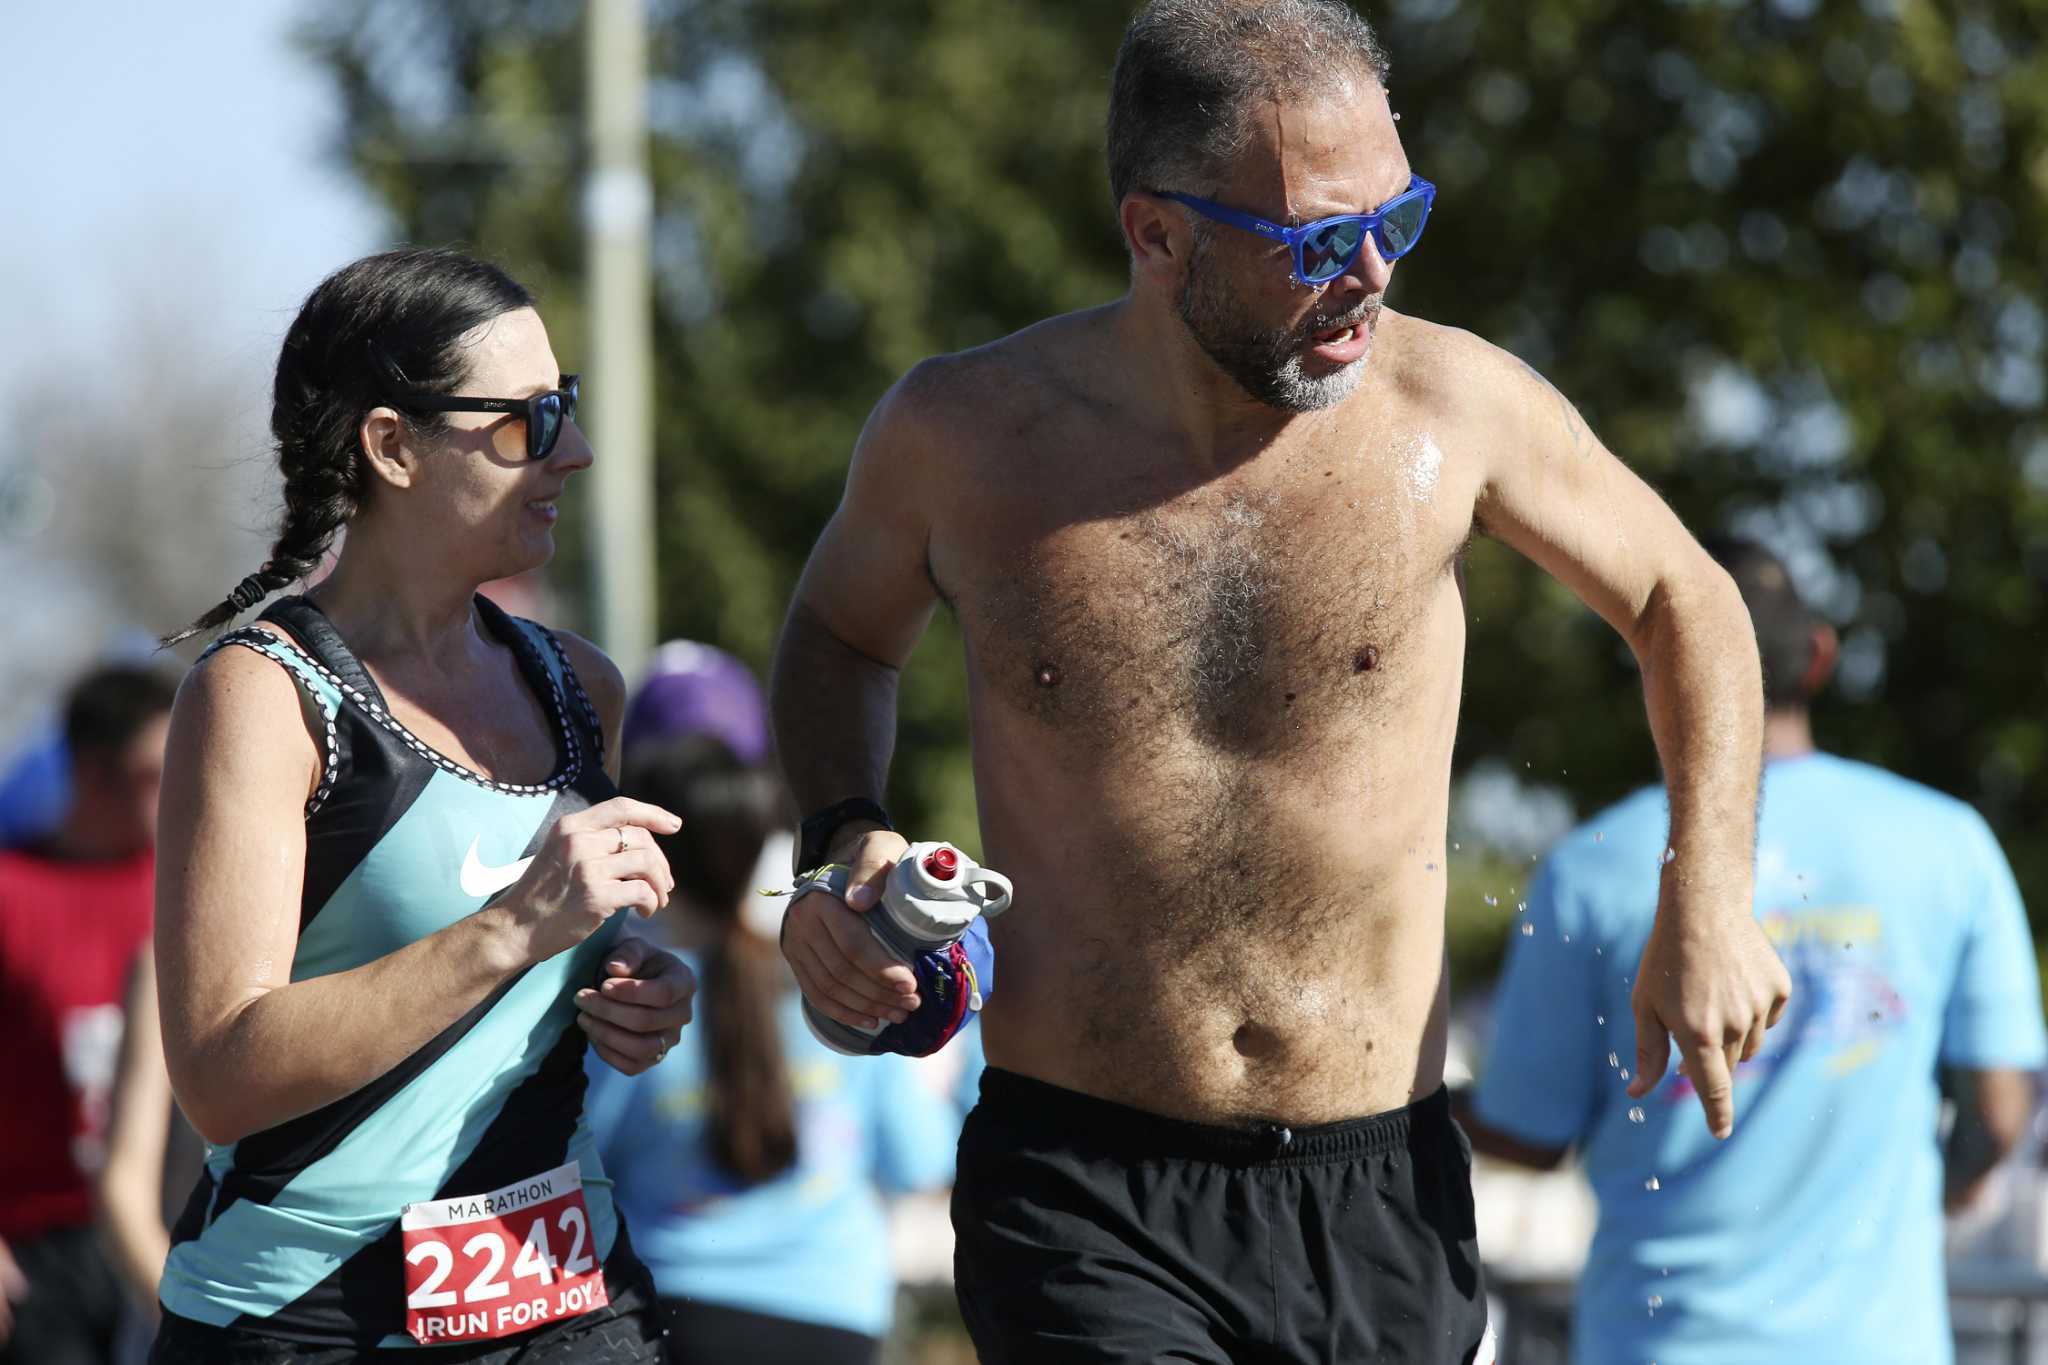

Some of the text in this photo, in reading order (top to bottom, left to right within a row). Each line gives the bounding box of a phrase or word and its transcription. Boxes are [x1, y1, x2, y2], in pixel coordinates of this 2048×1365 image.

[449, 1180, 553, 1220] MARATHON
[406, 1206, 592, 1309] 2242
[497, 1298, 548, 1329] FOR
[555, 1281, 592, 1316] JOY
